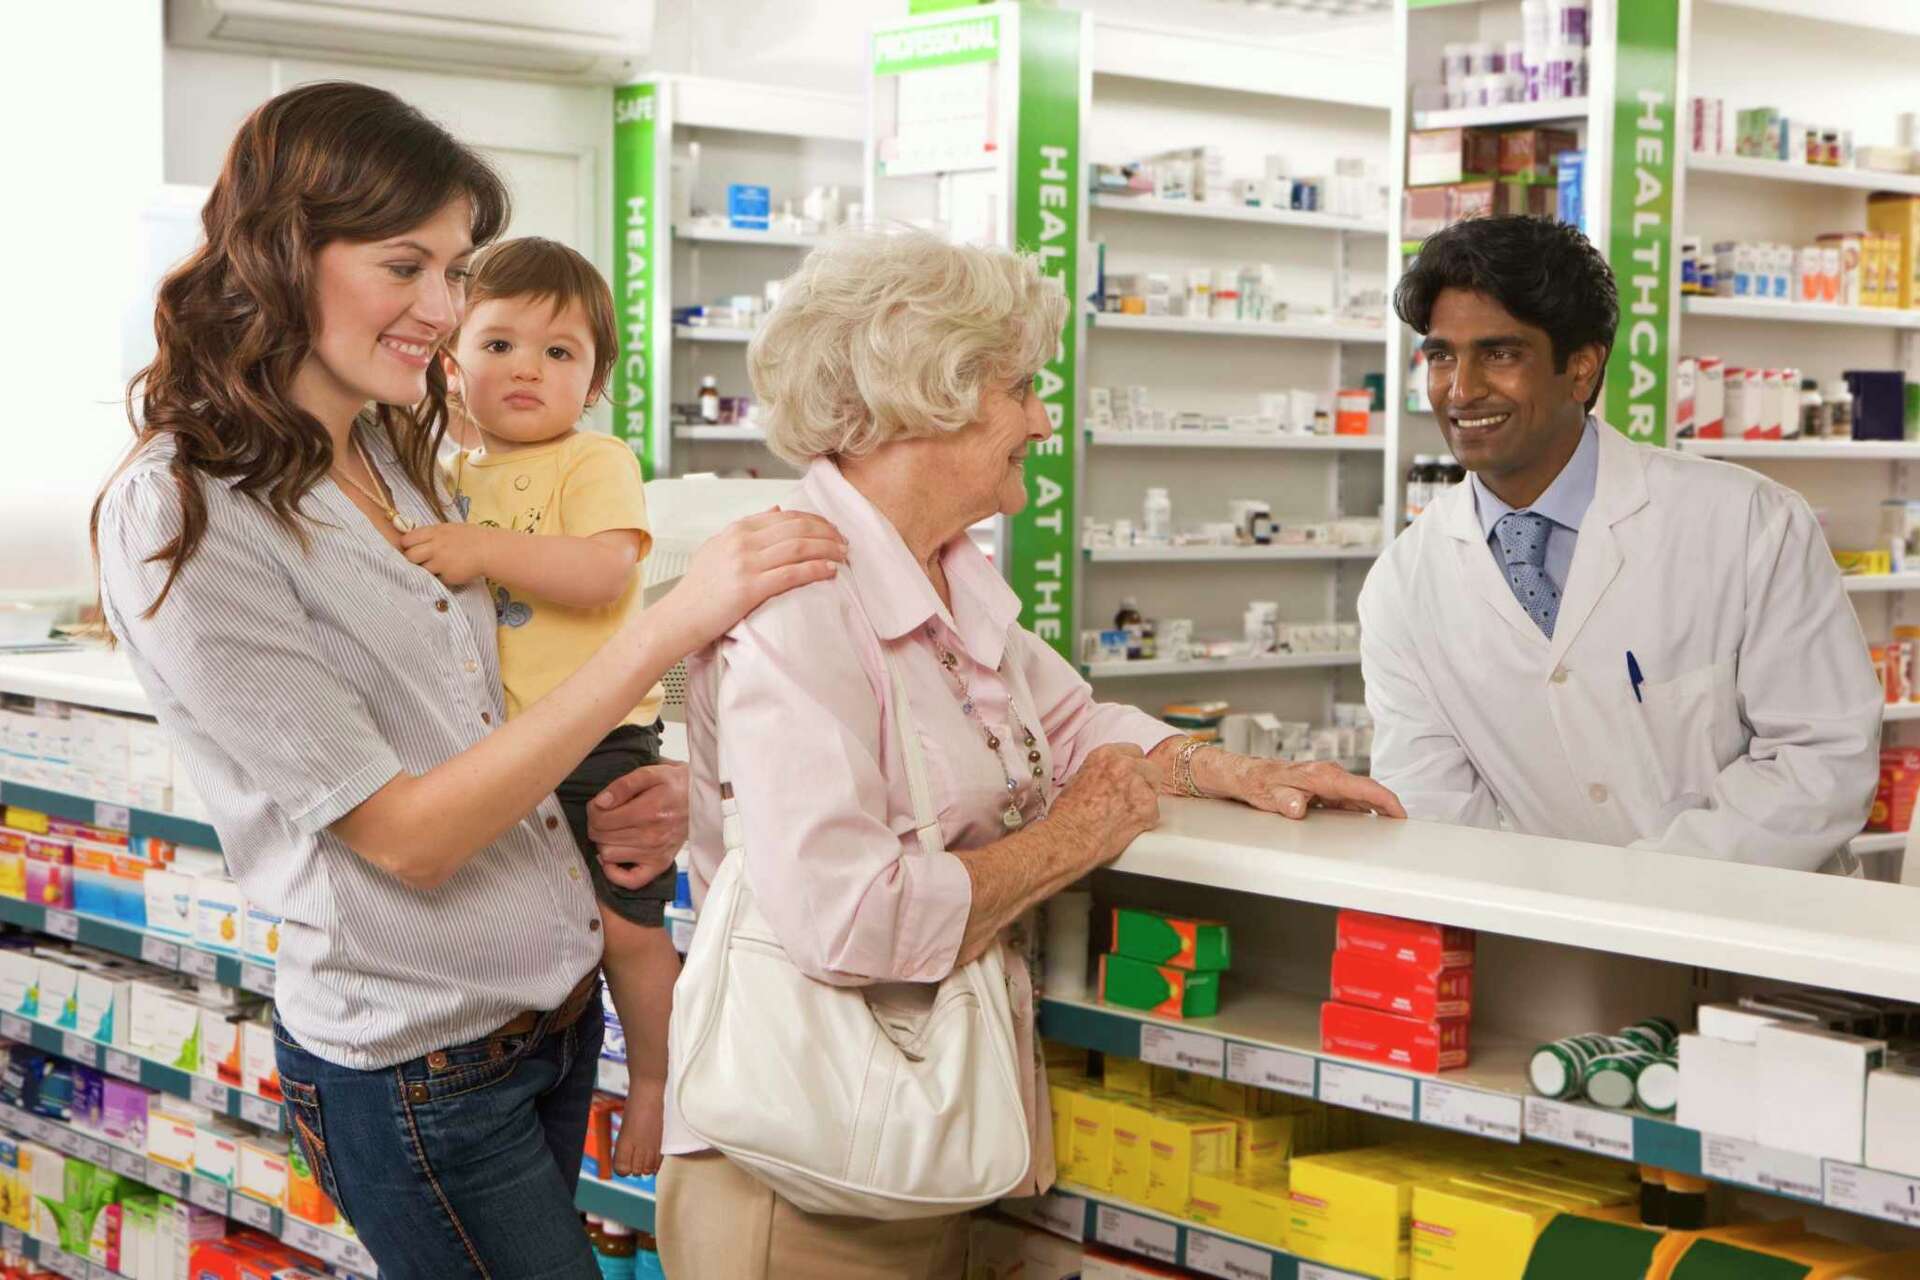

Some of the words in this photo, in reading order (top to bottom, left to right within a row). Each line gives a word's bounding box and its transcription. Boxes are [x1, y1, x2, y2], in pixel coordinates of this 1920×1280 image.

[876, 23, 997, 62] PROFESSIONAL
[616, 96, 655, 123] SAFE
[1627, 90, 1665, 445] HEALTHCAR
[1036, 475, 1062, 534] AT
[1034, 553, 1061, 640] THE
